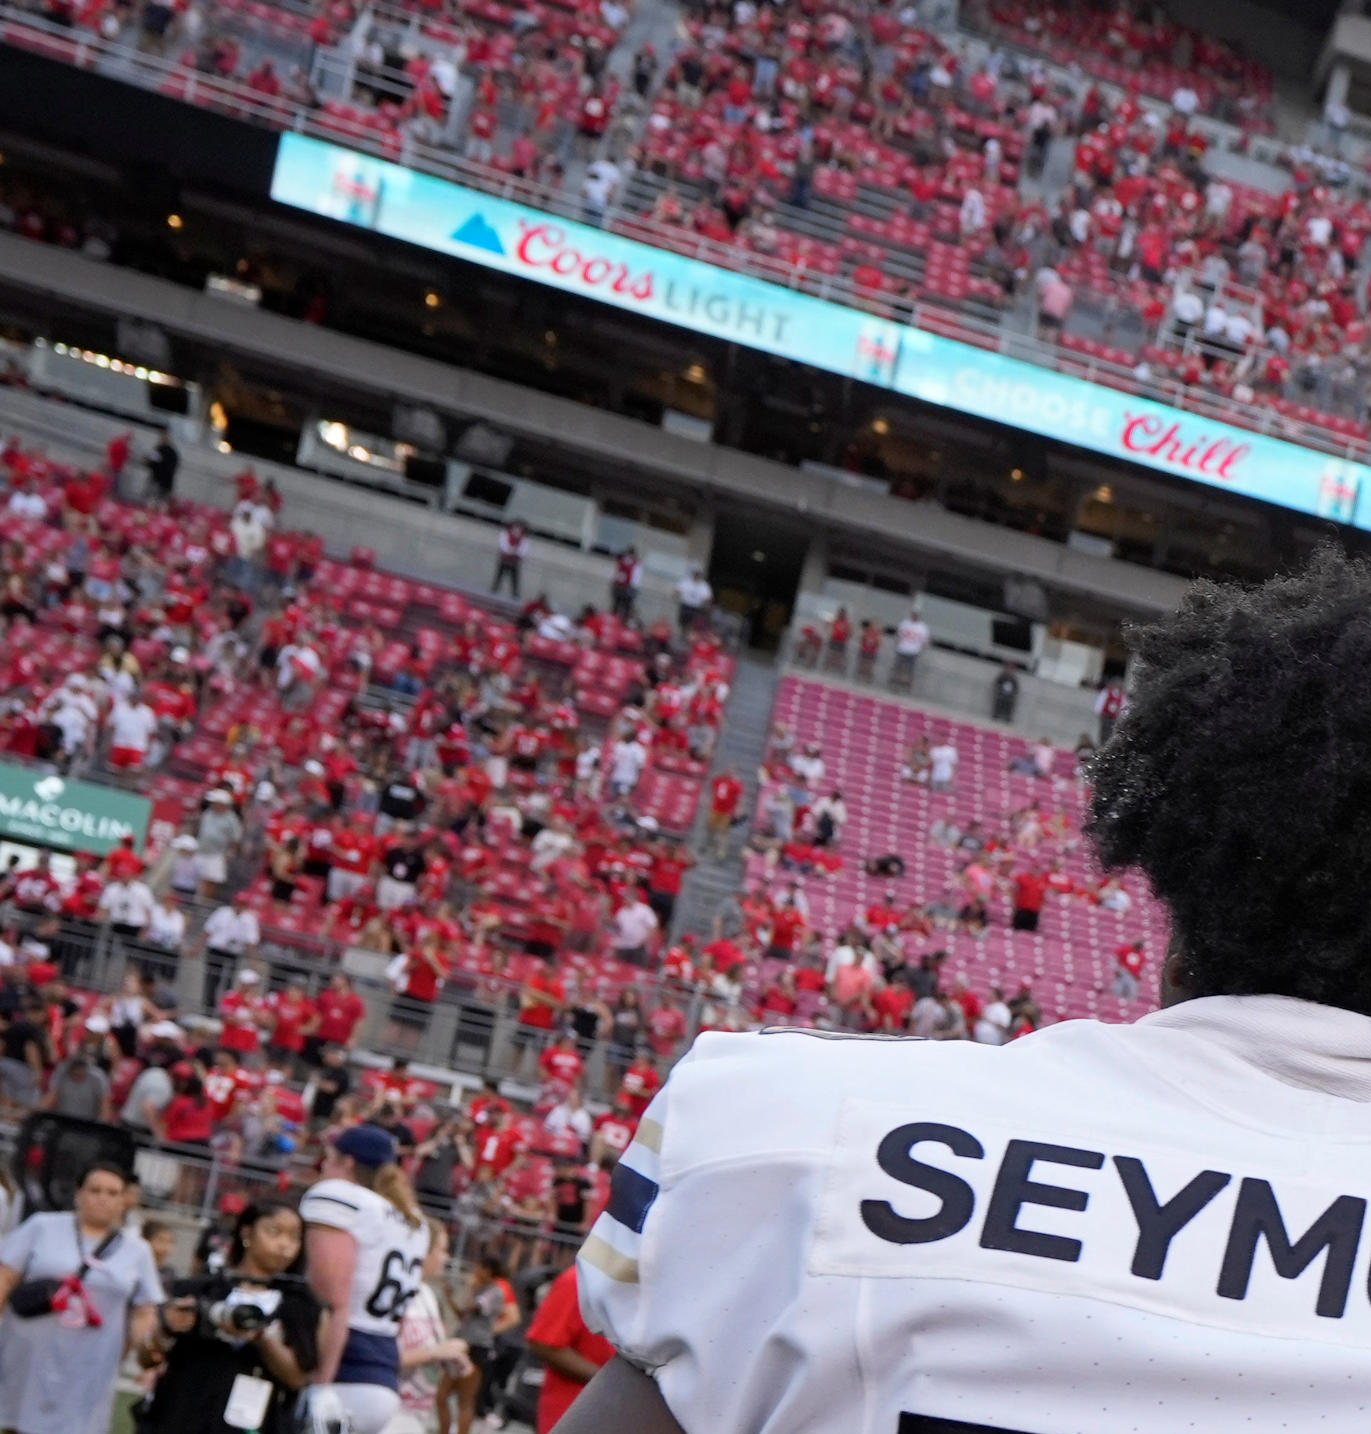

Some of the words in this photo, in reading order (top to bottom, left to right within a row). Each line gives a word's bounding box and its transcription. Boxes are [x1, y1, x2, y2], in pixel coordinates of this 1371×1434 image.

[518, 219, 654, 300] Coors
[663, 280, 791, 342] LIGHT
[952, 366, 1112, 438] CHOOSE
[1120, 410, 1250, 479] Chill
